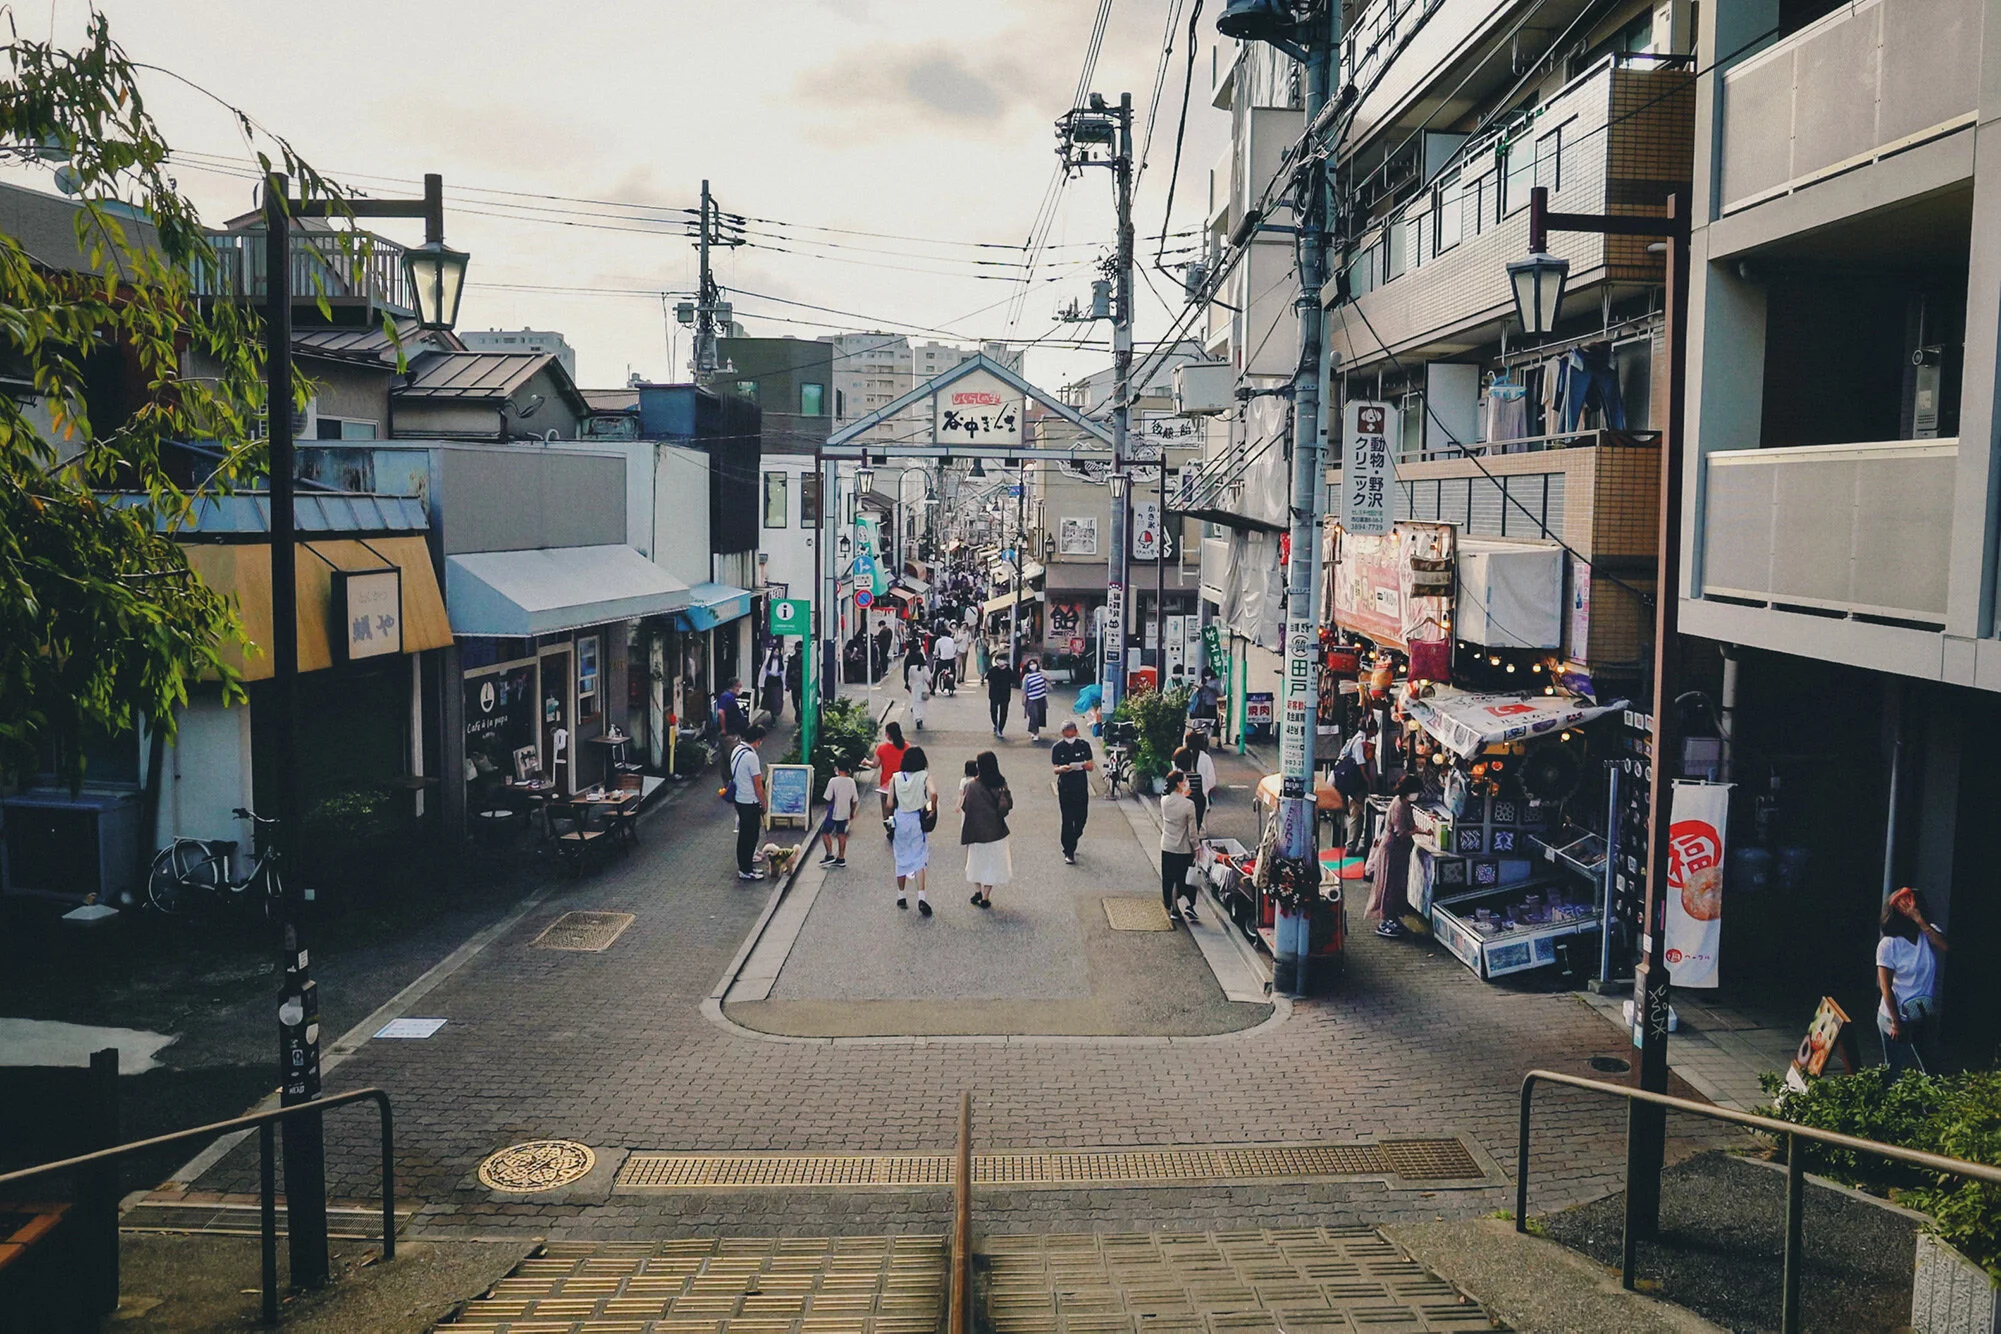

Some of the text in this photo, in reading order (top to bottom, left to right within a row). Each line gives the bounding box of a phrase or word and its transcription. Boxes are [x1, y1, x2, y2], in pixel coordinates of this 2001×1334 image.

[942, 402, 1017, 439] 谷中ぎんざ
[1353, 436, 1368, 507] クリニック
[1368, 436, 1386, 508] 動物・野沢
